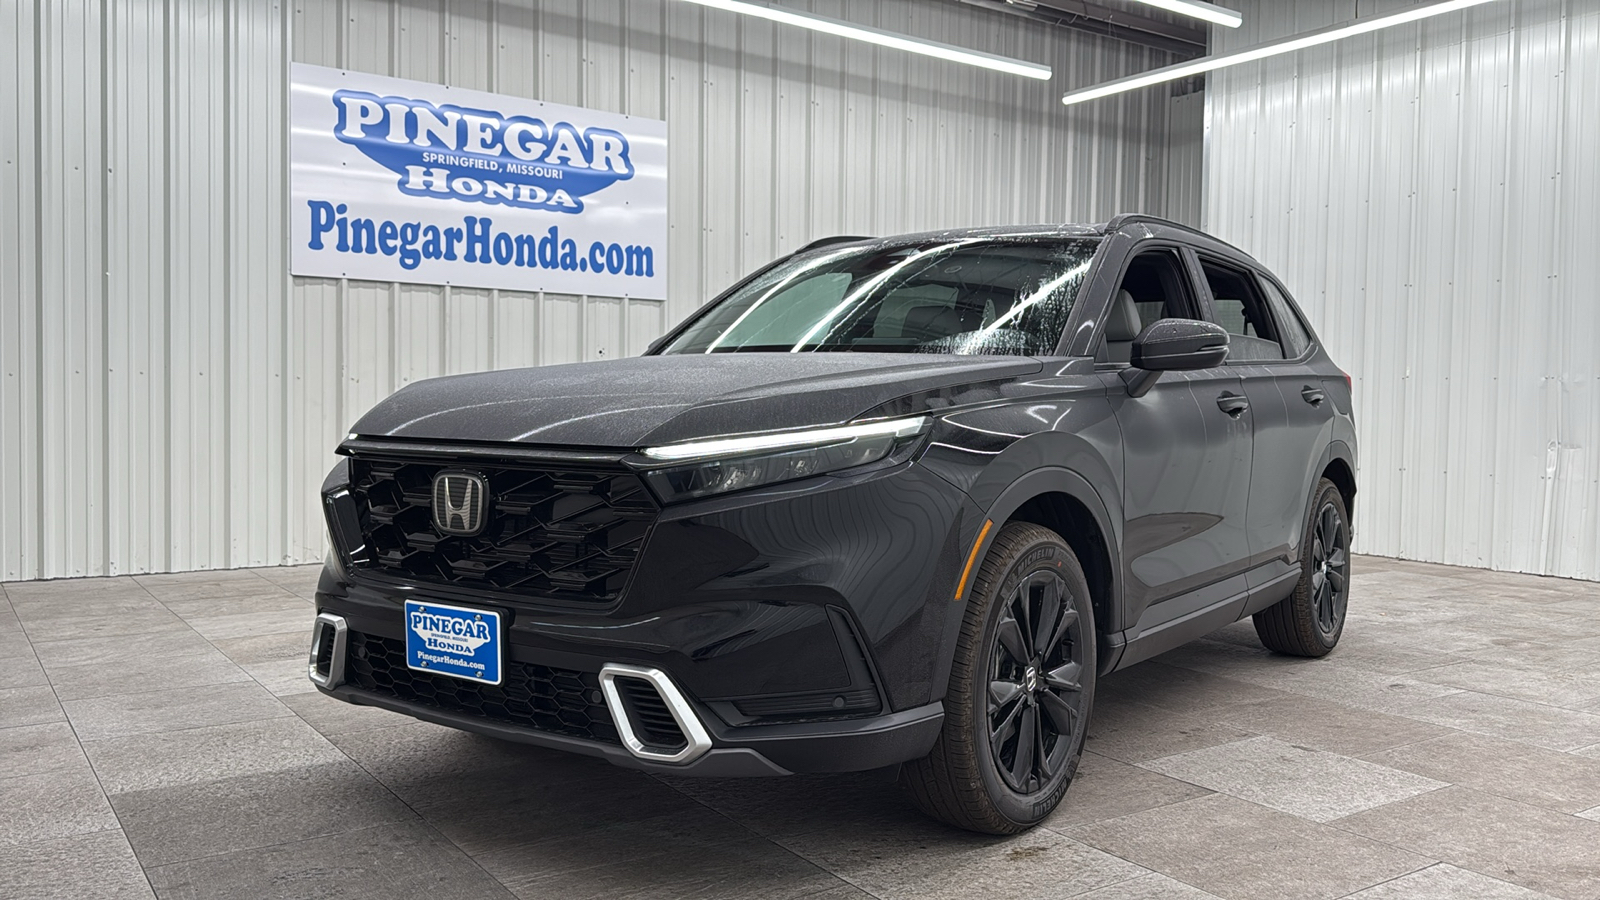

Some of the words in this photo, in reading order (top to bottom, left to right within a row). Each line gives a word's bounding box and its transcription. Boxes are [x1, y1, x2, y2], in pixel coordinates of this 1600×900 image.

[340, 97, 629, 175] PINEGAR
[422, 152, 504, 174] SPRINGFIELD,
[506, 163, 563, 180] MISSOURI
[404, 165, 579, 208] HONDA
[307, 200, 654, 277] PinegarHonda.com
[1017, 548, 1054, 575] MICHELIN
[412, 614, 489, 640] PINEGAR
[427, 638, 473, 654] HONDA
[417, 651, 485, 670] PinegarHonda.com
